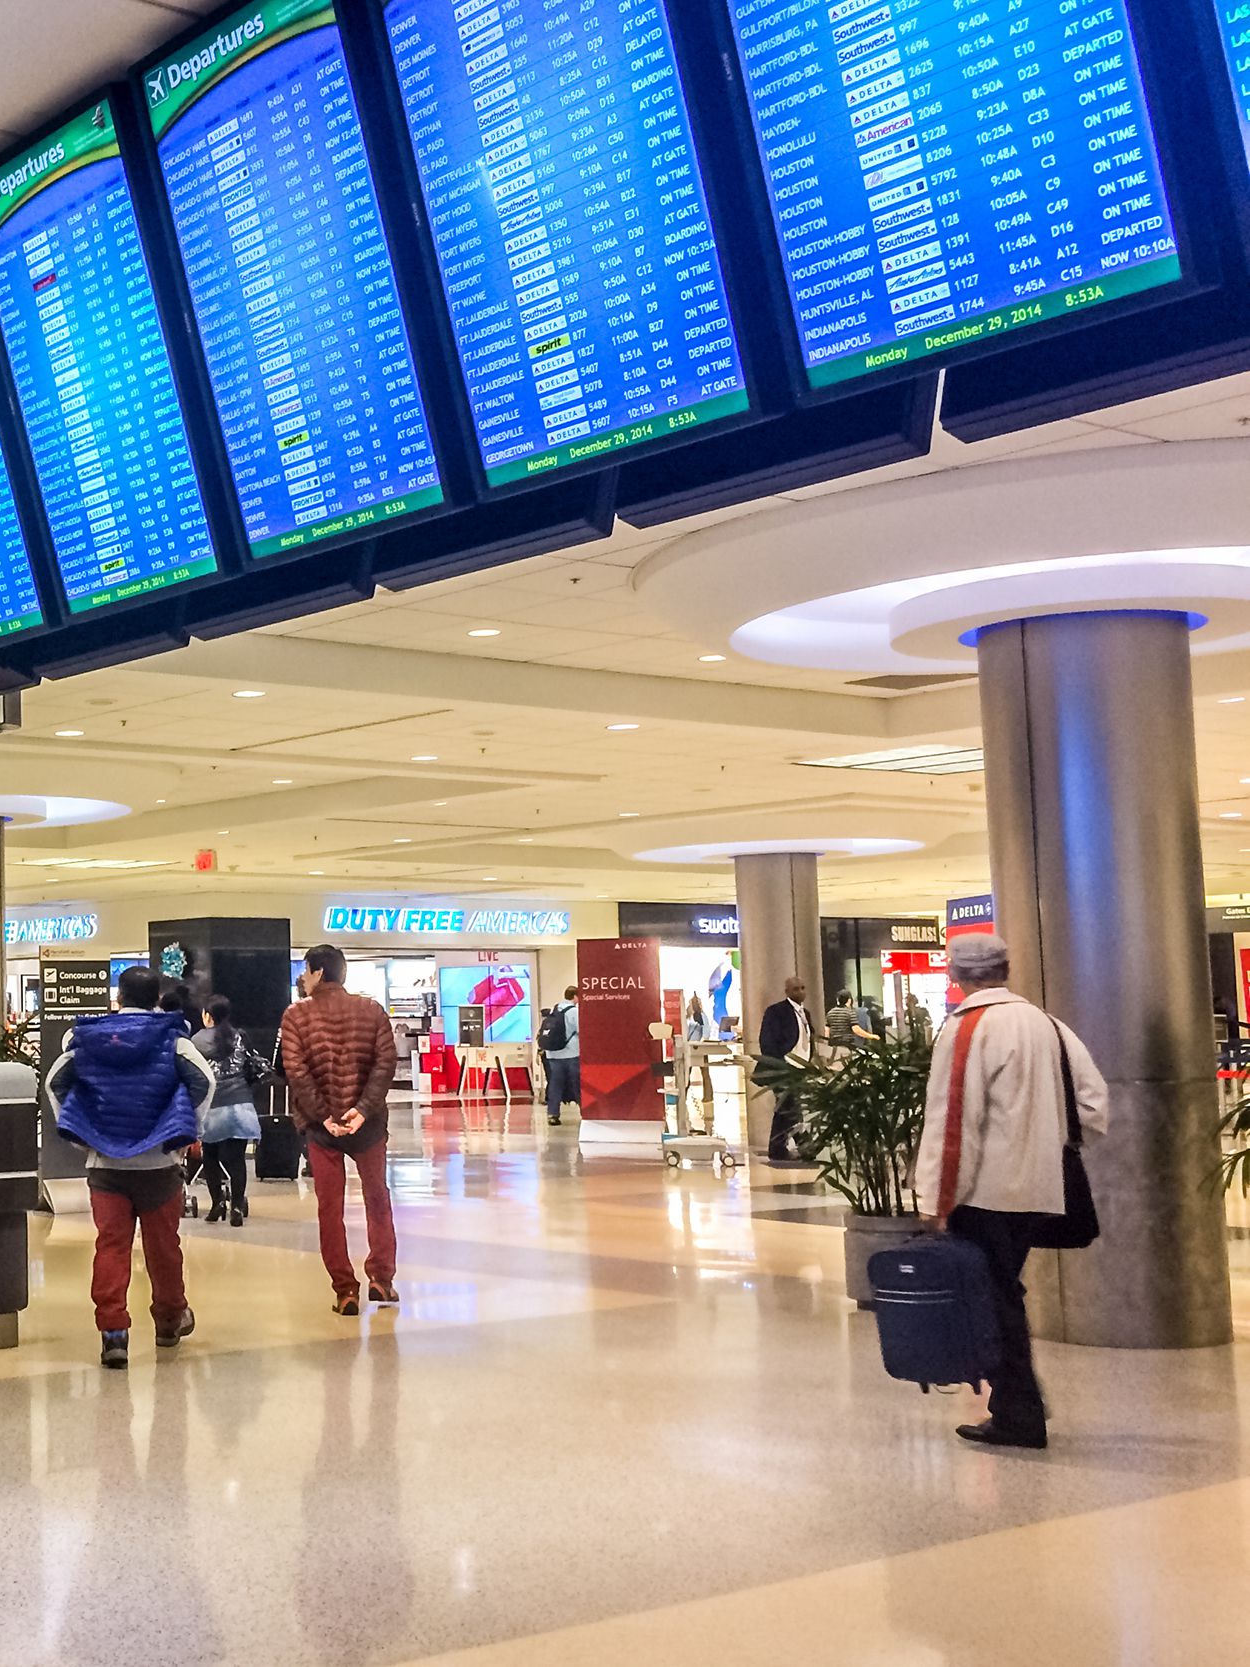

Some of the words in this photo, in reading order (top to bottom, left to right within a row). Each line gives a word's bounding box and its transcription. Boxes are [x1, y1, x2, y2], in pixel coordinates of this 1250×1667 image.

[167, 12, 265, 89] Departures
[769, 154, 814, 181] HOUSTON
[866, 116, 913, 141] American
[916, 101, 942, 120] 2065
[971, 79, 1003, 99] 8:50A
[1017, 62, 1039, 80] D23
[1062, 29, 1123, 62] DEPARTED
[773, 175, 818, 201] HOUSTON
[862, 149, 892, 164] UNITED
[921, 124, 947, 142] 5228
[976, 100, 1008, 120] 9:23A
[1022, 86, 1045, 103] D8A
[1073, 66, 1091, 82] ON
[1093, 54, 1123, 74] TIME
[778, 195, 823, 221] HOUSTON
[925, 144, 952, 163] 8206
[976, 123, 1013, 144] 10:25A
[1027, 107, 1049, 124] C33
[1078, 89, 1096, 105] ON
[1097, 77, 1127, 97] TIME
[782, 215, 827, 241] HOUSTON
[871, 191, 901, 206] UNITED
[930, 167, 957, 185] 5792
[980, 144, 1017, 166] 10:48A
[1031, 130, 1054, 148] D10
[1083, 112, 1101, 128] ON
[1102, 100, 1132, 120] TIME
[787, 223, 865, 261] HOUSTON-HOBBY
[872, 204, 926, 232] Southwest
[936, 188, 960, 206] 1831
[990, 167, 1022, 186] 9:40A
[1040, 154, 1055, 168] C3
[1088, 135, 1106, 151] ON
[1107, 124, 1137, 144] TIME
[791, 244, 870, 281] HOUSTON-HOBBY
[876, 225, 930, 253] Southwest
[941, 212, 959, 227] 128
[989, 189, 1027, 210] 10:05A
[1045, 176, 1060, 190] C9
[1093, 158, 1111, 174] ON
[1112, 147, 1142, 166] TIME
[795, 264, 874, 301] HOUSTON-HOBBY
[894, 249, 928, 266] DELTA
[945, 231, 969, 249] 1391
[994, 211, 1031, 232] 10:49A
[1046, 198, 1068, 214] C49
[1097, 181, 1116, 196] ON
[1117, 170, 1147, 189] TIME
[799, 293, 859, 321] HUNTSVILLE,
[861, 288, 874, 301] AL
[948, 252, 974, 270] 5443
[999, 233, 1036, 253] 11:45A
[1050, 220, 1073, 237] D16
[1102, 204, 1120, 219] ON
[1122, 193, 1152, 212] TIME
[804, 311, 866, 341] INDIANAPOLIS
[903, 290, 937, 307] DELTA
[954, 273, 978, 291] 1127
[1008, 255, 1041, 274] 8:41A
[1056, 242, 1078, 259] A12
[1100, 215, 1162, 244] DEPARTED
[808, 332, 871, 361] INDIANAPOLIS
[896, 309, 948, 333] Southwest
[959, 296, 984, 312] 1744
[1013, 277, 1046, 296] 9:45A
[1060, 264, 1082, 281] C15
[1100, 249, 1129, 269] NOW
[1133, 236, 1175, 258] 10:10A
[535, 337, 561, 354] spirit
[572, 327, 586, 340] 877
[607, 310, 634, 327] 10:16A
[646, 301, 657, 313] D9
[680, 288, 693, 300] ON
[694, 279, 715, 295] TIME
[865, 347, 907, 368] Monday
[924, 323, 984, 349] December
[987, 315, 1007, 330] 29,
[1010, 303, 1041, 323] 2014
[1064, 285, 1103, 306] 8:53A
[552, 410, 577, 423] DELTA
[587, 398, 607, 412] 5489
[623, 384, 651, 400] 10:55A
[659, 375, 676, 388] D44
[696, 363, 710, 376] ON
[710, 356, 732, 371] TIME
[556, 427, 581, 440] DELTA
[591, 414, 610, 429] 5607
[627, 402, 654, 418] 10:15A
[666, 394, 678, 406] F5
[701, 382, 712, 396] AT
[713, 375, 737, 391] GATE
[527, 455, 557, 471] Monday
[569, 438, 611, 458] December
[613, 432, 628, 444] 29,
[630, 423, 652, 439] 2014
[668, 411, 696, 427] 8:53A
[312, 522, 344, 537] December
[358, 511, 375, 523] 2014
[325, 906, 400, 932] DUTY
[400, 907, 464, 933] FREE
[959, 905, 984, 918] DELTA
[59, 971, 97, 980] Concourse
[59, 985, 74, 994] Int'l
[75, 985, 107, 995] Baggage
[59, 996, 81, 1004] Claim
[582, 976, 646, 991] SPECIAL
[582, 993, 604, 1001] Special
[604, 993, 631, 1001] Services
